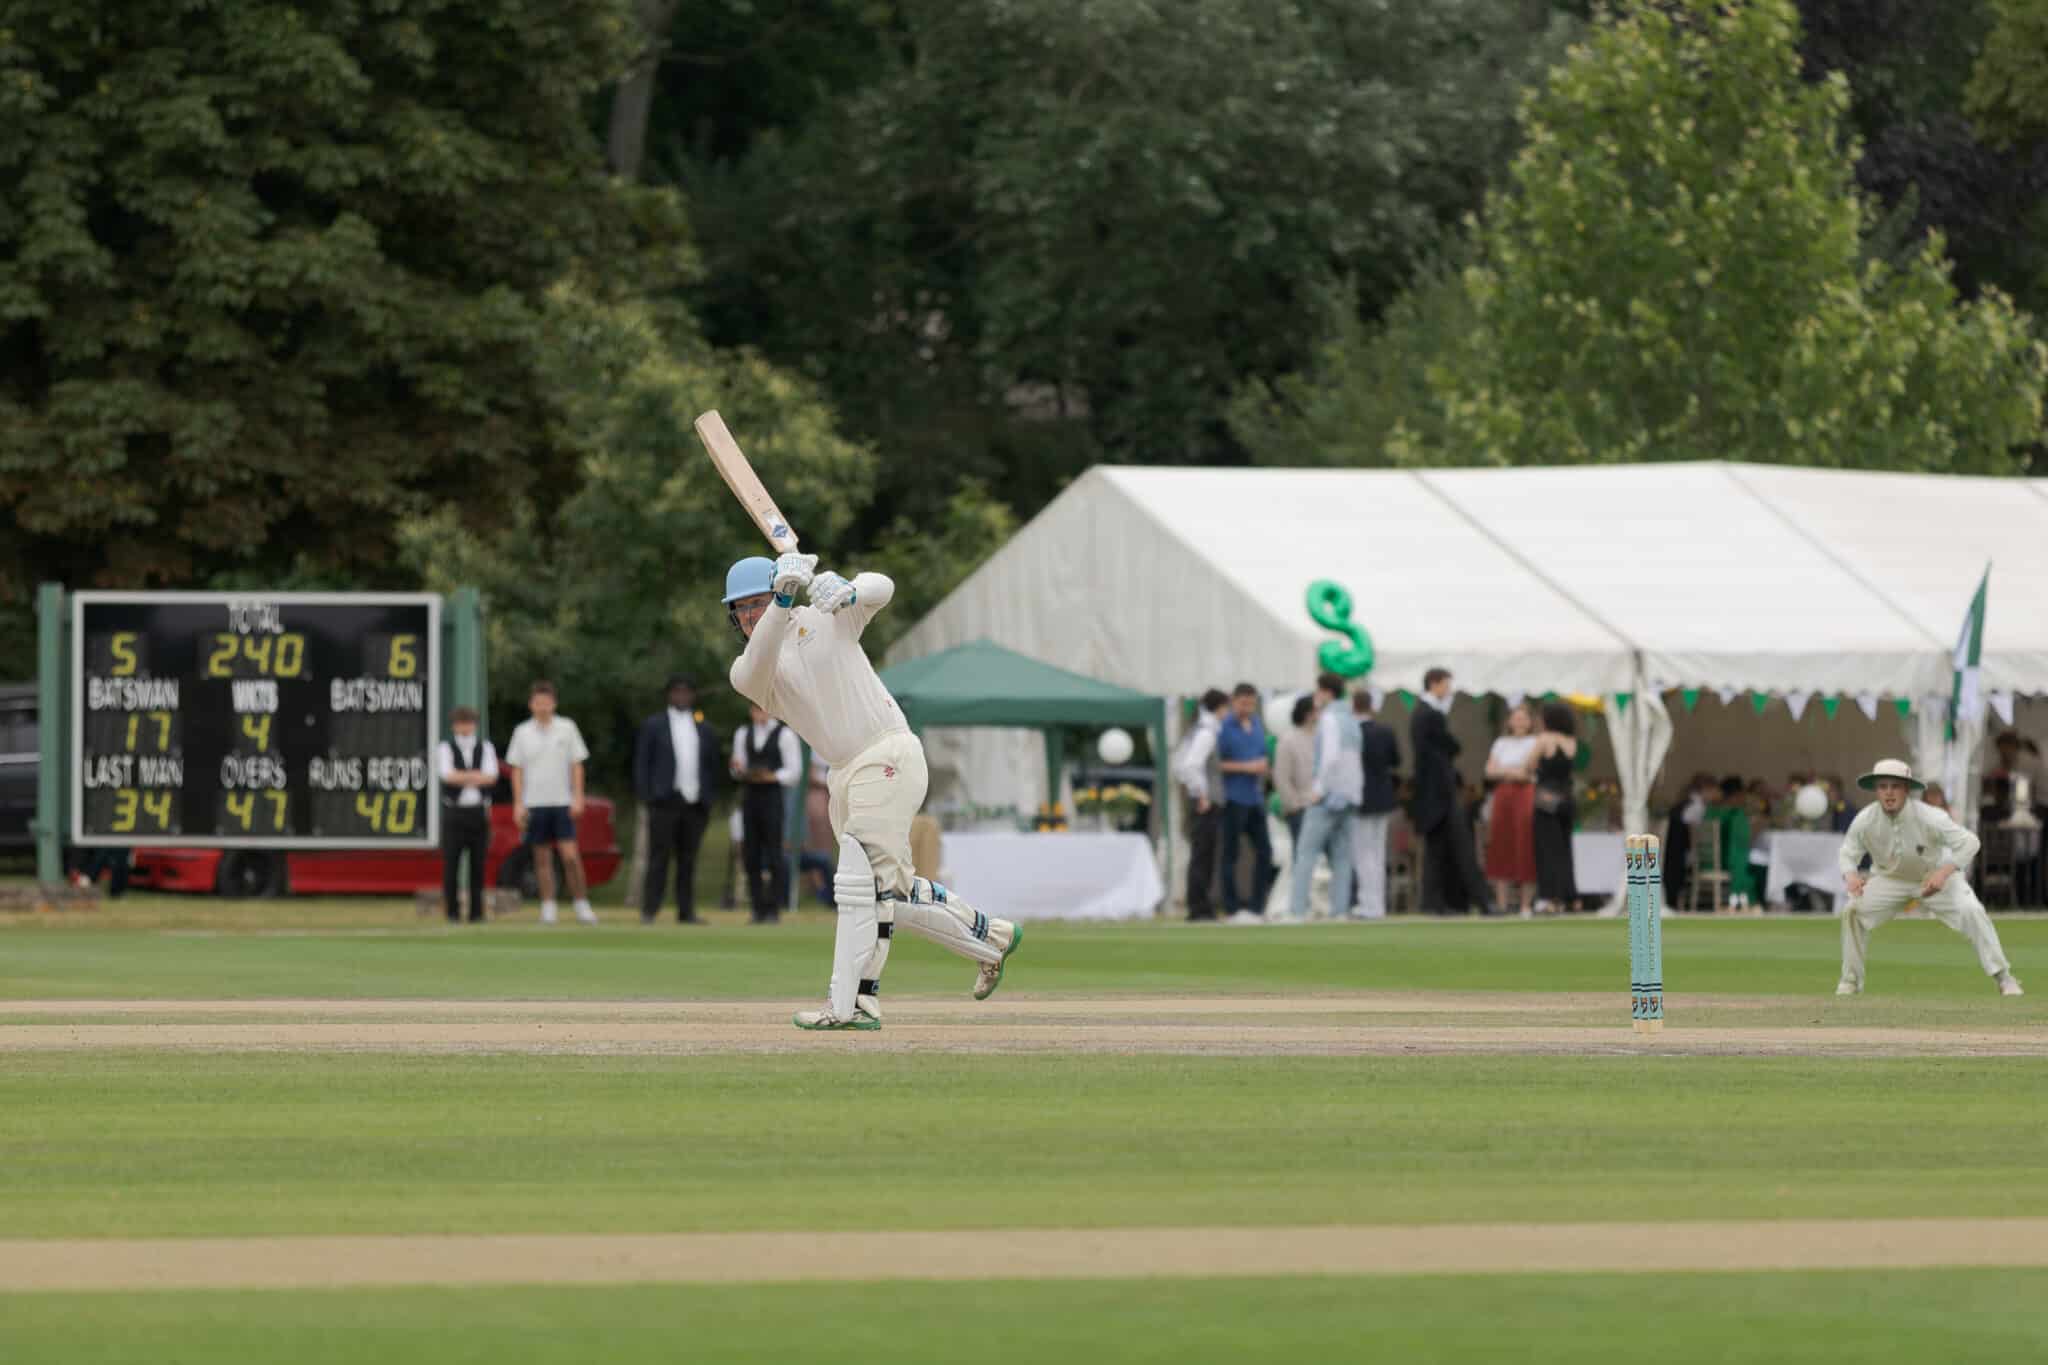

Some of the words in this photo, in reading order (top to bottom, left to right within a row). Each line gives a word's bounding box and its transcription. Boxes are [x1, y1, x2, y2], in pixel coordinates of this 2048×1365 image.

[229, 600, 283, 633] TOTAL
[111, 633, 137, 676] 5
[208, 634, 304, 677] 240
[388, 635, 416, 678] 6
[88, 679, 179, 711] BATSMAN
[330, 679, 423, 711] BATSMAN
[126, 712, 171, 751] 17
[242, 714, 271, 751] 4
[84, 757, 133, 787] LAST
[138, 757, 183, 787] MAN
[220, 757, 286, 788] OVERS
[308, 757, 362, 789] RUNS
[112, 789, 172, 831] 34
[226, 791, 288, 830] 47
[356, 791, 417, 833] 40
